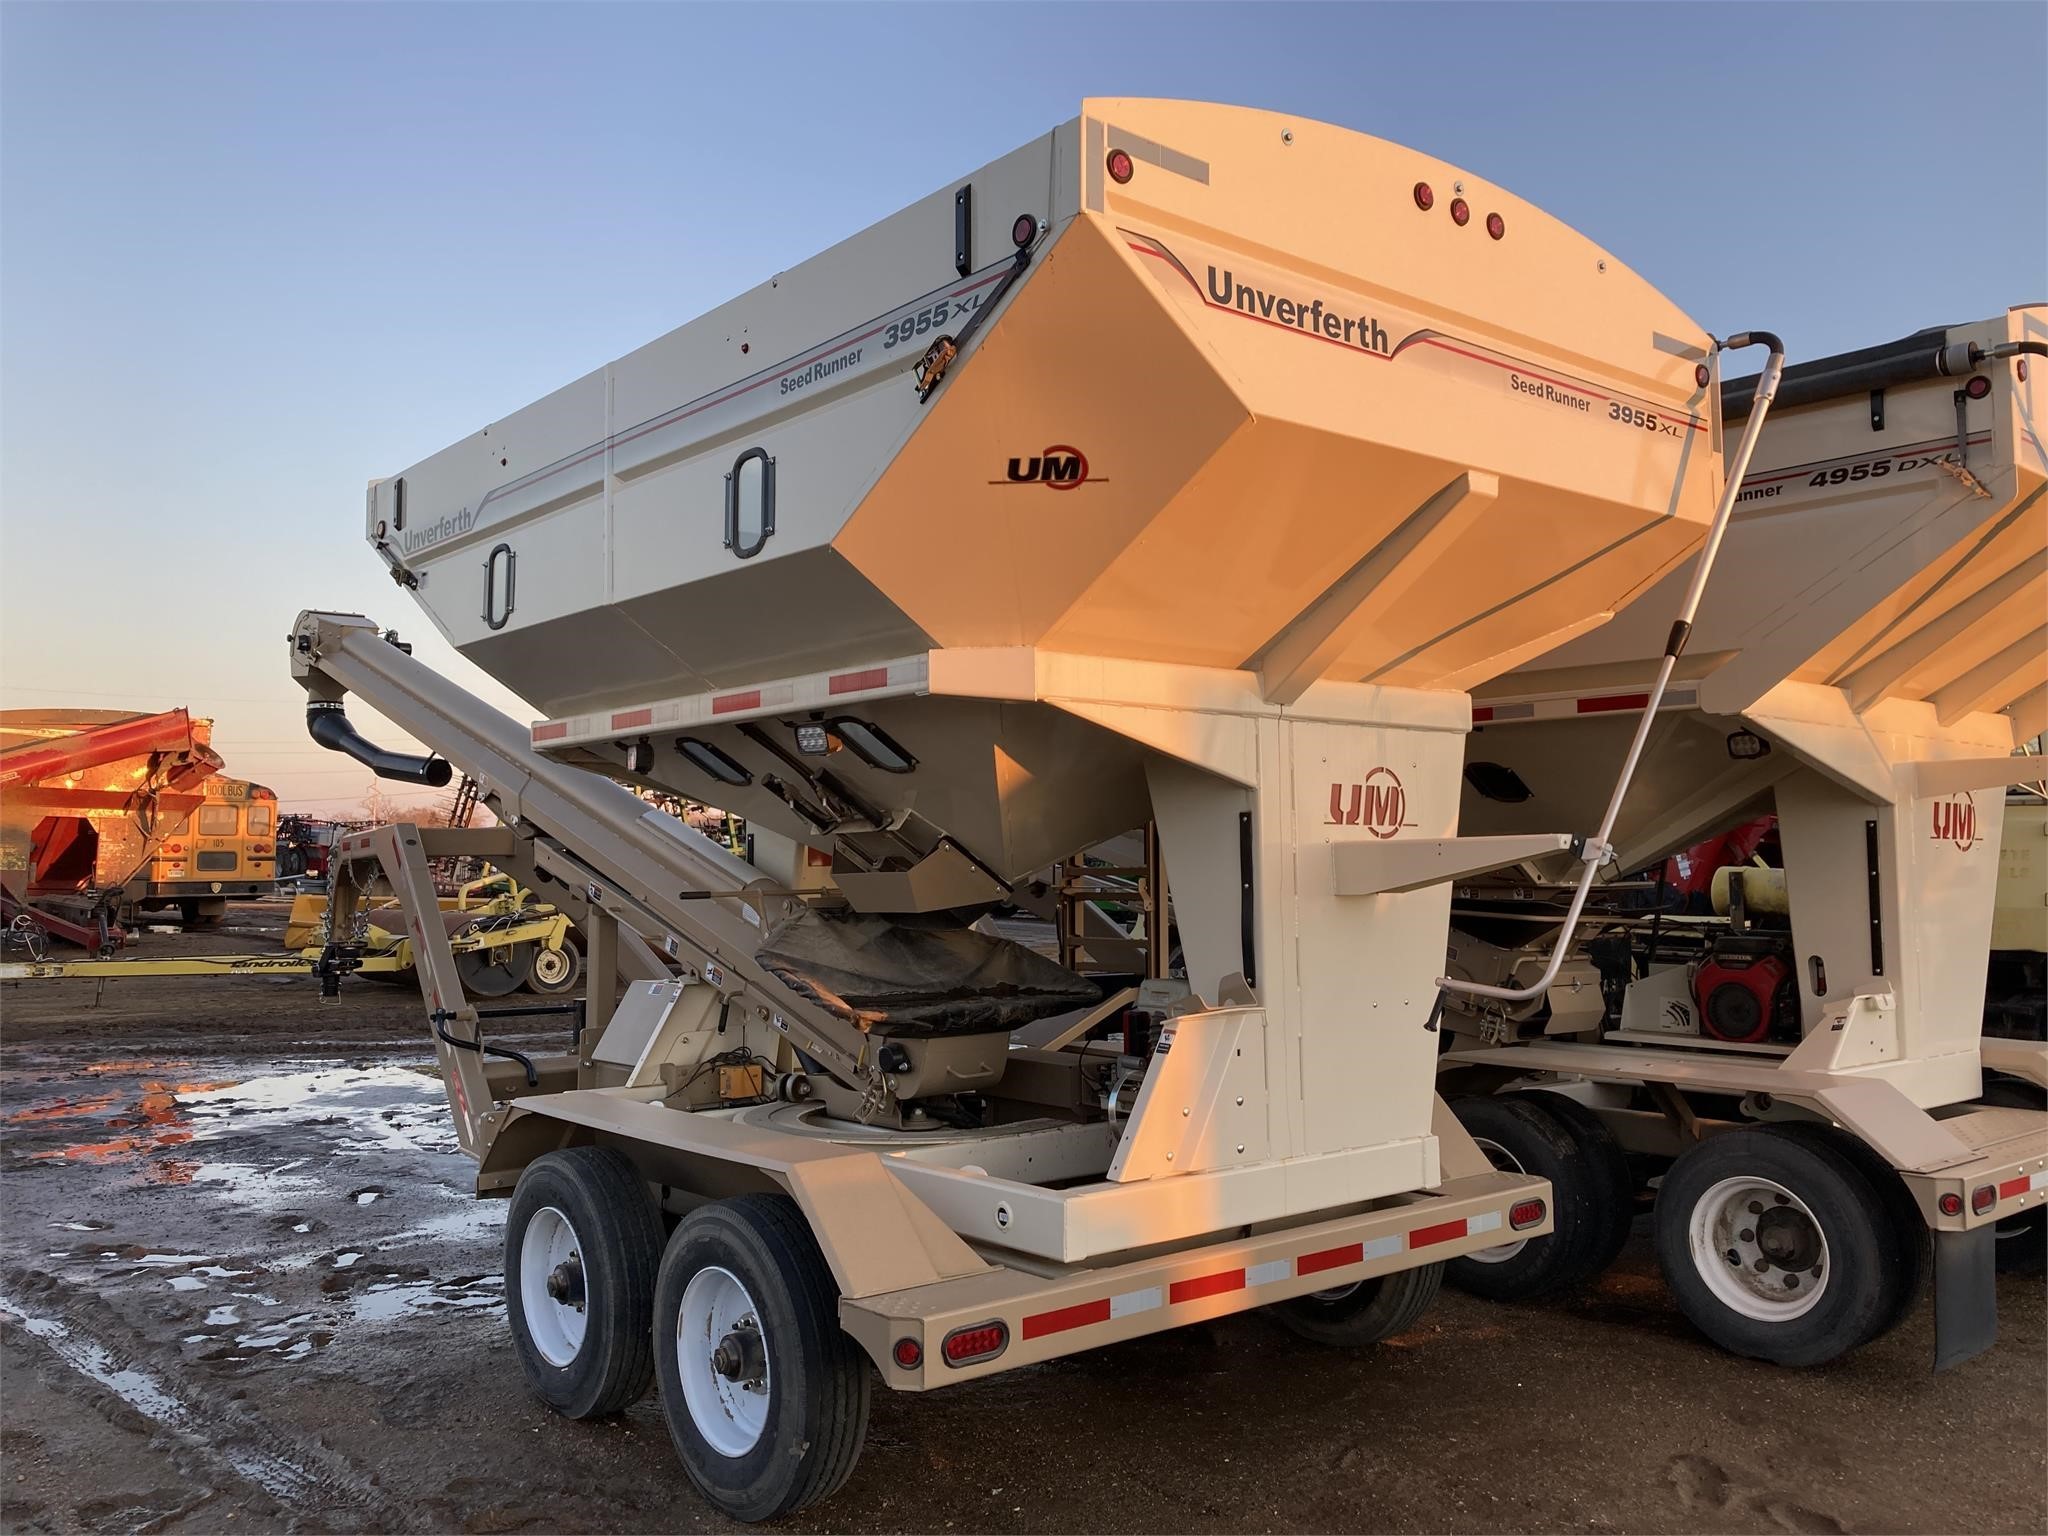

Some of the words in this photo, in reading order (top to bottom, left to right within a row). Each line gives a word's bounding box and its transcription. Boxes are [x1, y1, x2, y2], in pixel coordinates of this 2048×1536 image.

[1208, 265, 1389, 354] Unverferth
[780, 366, 813, 396] Seed
[814, 348, 863, 381] Runner
[883, 300, 950, 350] 3955
[950, 294, 985, 319] XL
[1511, 373, 1544, 399] Seed
[1545, 385, 1591, 412] Runner
[1608, 402, 1657, 432] 3955
[1658, 423, 1684, 439] XL
[1735, 484, 1784, 502] unner
[1809, 459, 1891, 487] 4955
[404, 507, 471, 552] Unverferth
[228, 785, 243, 797] BUS
